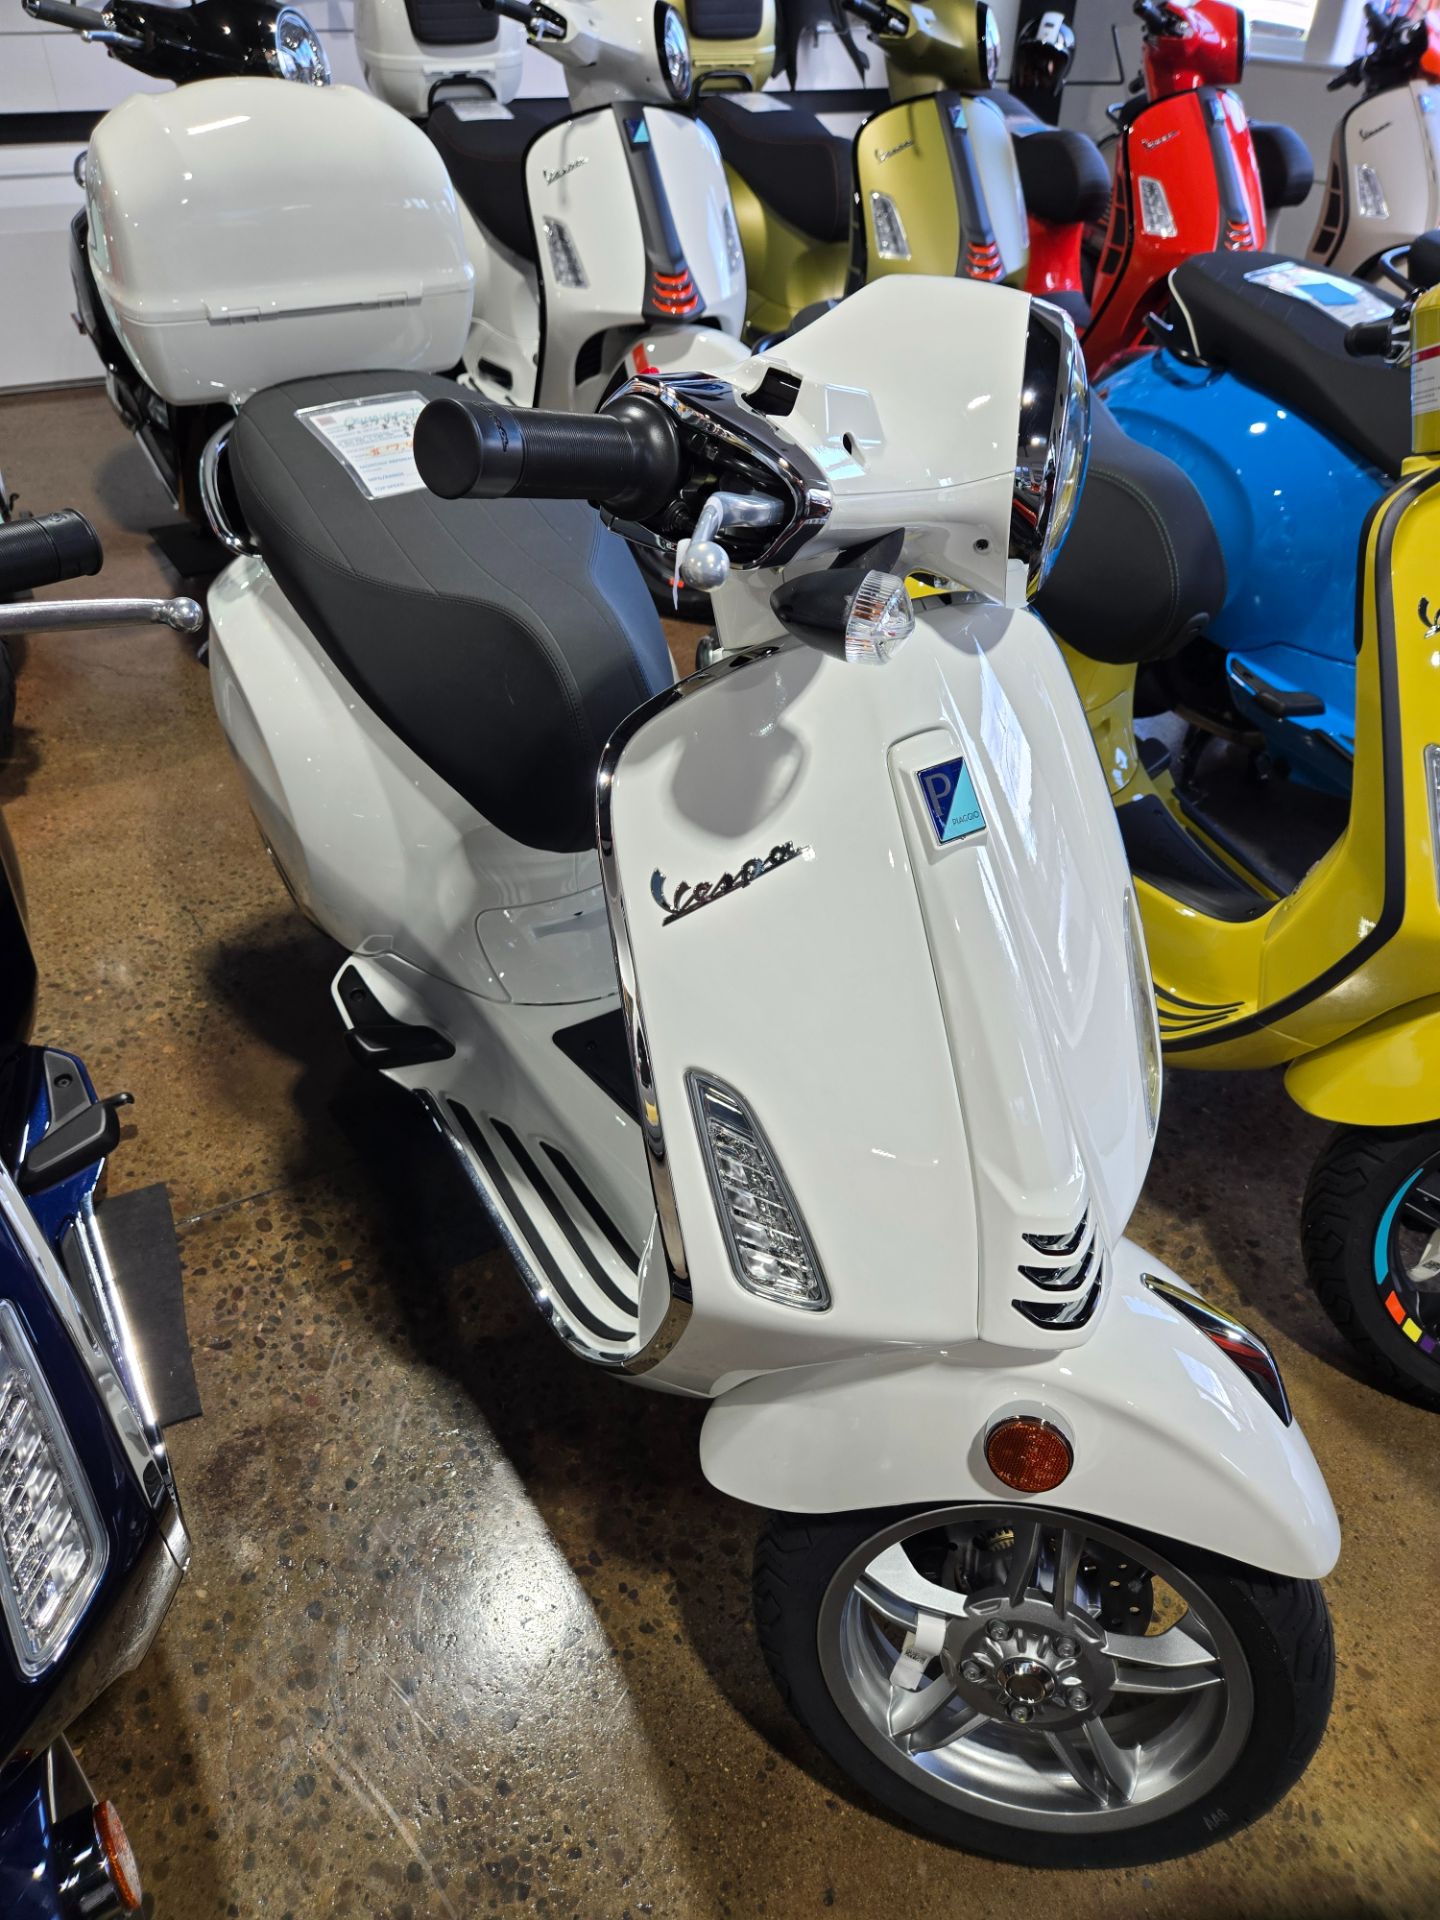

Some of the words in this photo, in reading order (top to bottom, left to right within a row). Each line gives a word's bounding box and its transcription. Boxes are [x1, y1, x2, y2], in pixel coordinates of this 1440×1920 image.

[923, 772, 951, 817] P
[951, 810, 980, 826] PIAGGIO
[650, 840, 815, 927] Vespa
